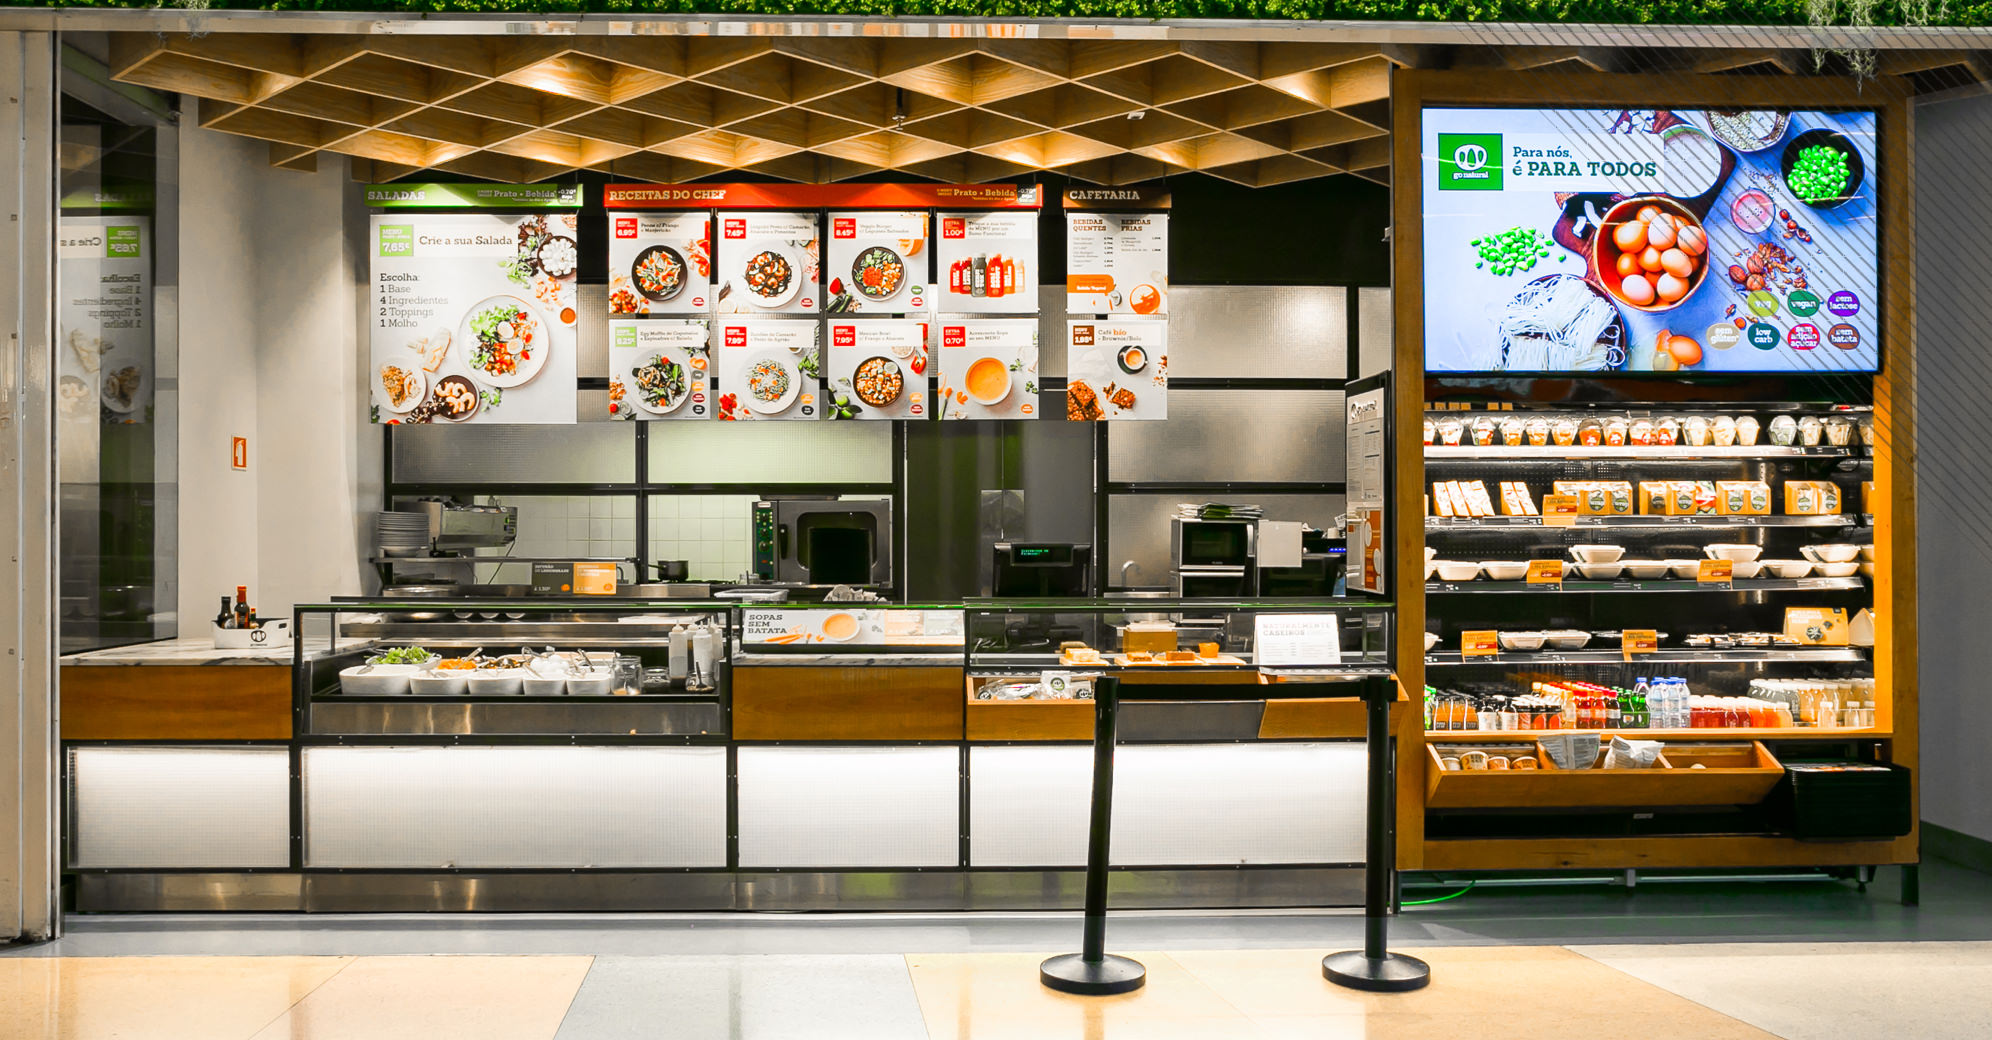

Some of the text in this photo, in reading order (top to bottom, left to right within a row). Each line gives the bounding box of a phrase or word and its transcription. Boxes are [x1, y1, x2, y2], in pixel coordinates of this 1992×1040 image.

[1513, 145, 1573, 159] Para nós,
[1512, 160, 1657, 176] é PARA TODOS
[1453, 171, 1489, 180] go natural
[368, 191, 426, 200] SALADAS
[609, 190, 726, 200] RECEITAS DO CHEF
[1070, 190, 1140, 200] CAFETARIA
[420, 236, 442, 246] Crie
[445, 238, 450, 246] a
[454, 238, 472, 246] sua
[475, 236, 512, 246] Salada
[388, 284, 410, 293] Base
[380, 296, 448, 306] 4 Ingredientes
[1754, 300, 1772, 308] veg
[1790, 300, 1816, 310] vegan
[1830, 302, 1858, 310] lactose
[380, 308, 434, 318] 2 Toppings
[380, 319, 418, 328] 1 Molho
[1756, 328, 1772, 336] low
[1831, 334, 1858, 343] batata
